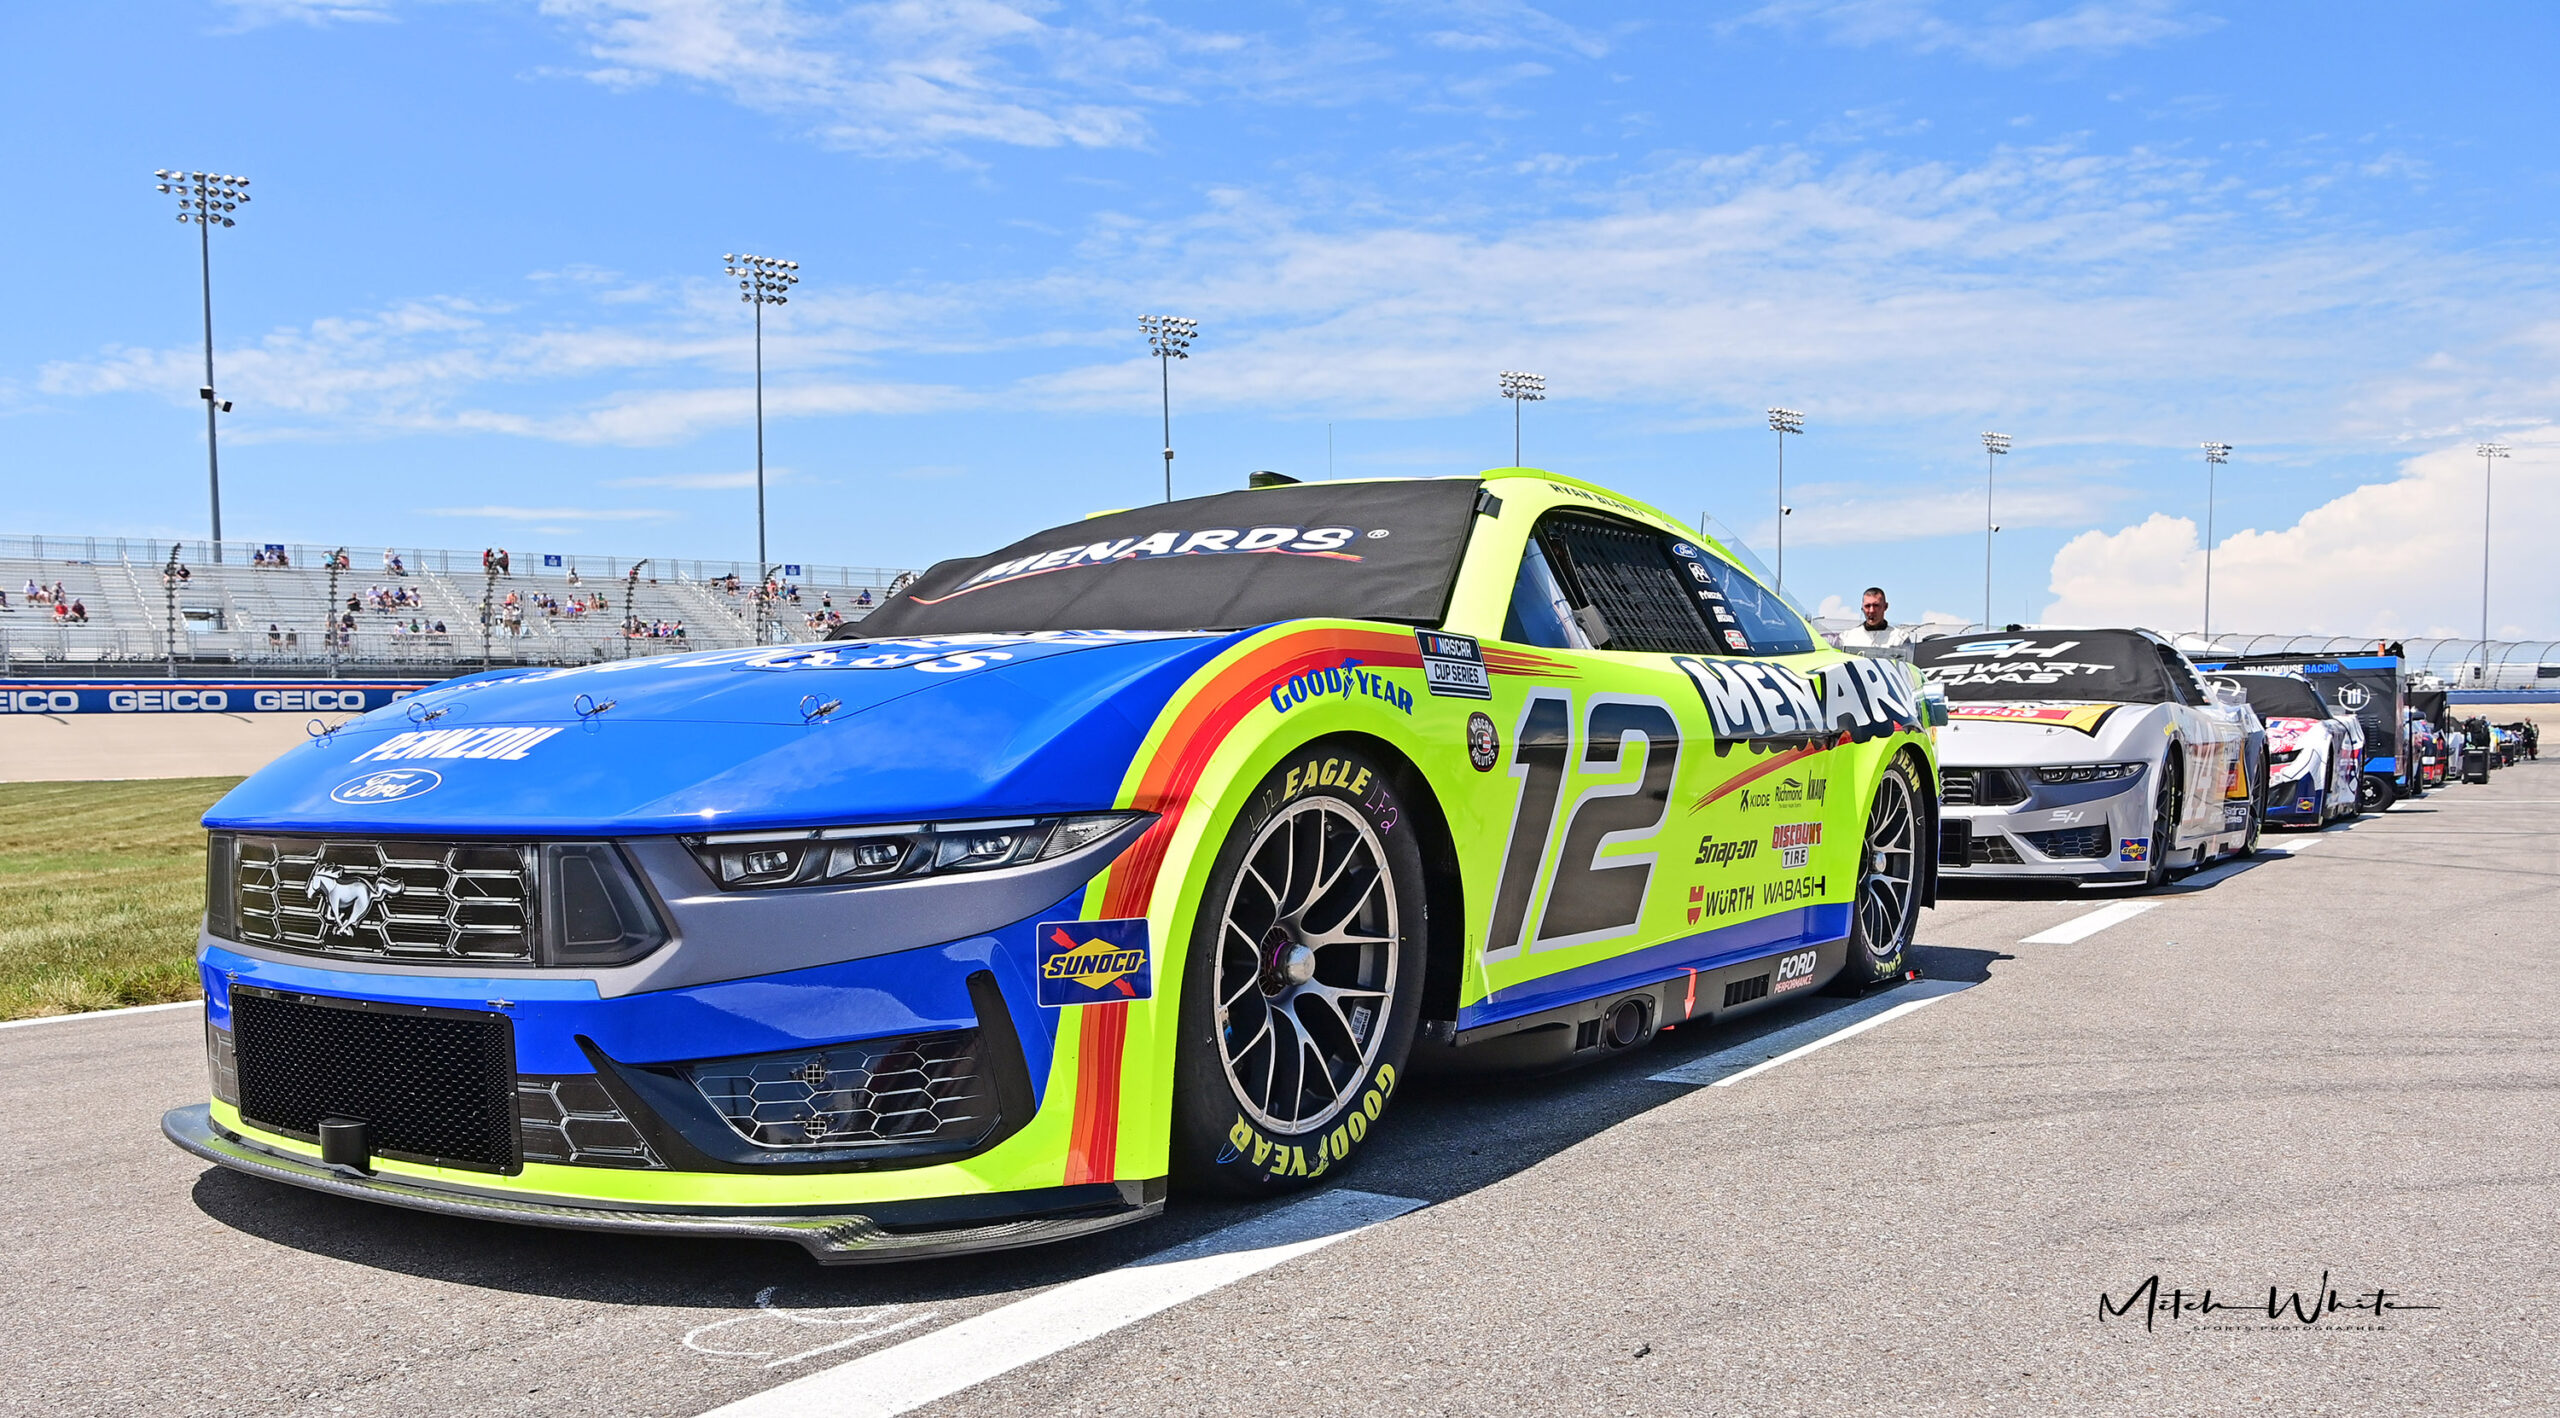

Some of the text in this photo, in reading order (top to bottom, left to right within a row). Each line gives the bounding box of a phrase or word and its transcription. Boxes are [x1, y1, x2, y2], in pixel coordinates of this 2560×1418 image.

[1549, 483, 1593, 501] RYAN
[973, 526, 1354, 584] MENARDS
[1438, 636, 1472, 659] NASCAR
[1434, 663, 1479, 684] CUP SERIES
[1921, 662, 2115, 676] TEWART
[2304, 664, 2339, 674] RACING
[109, 691, 228, 712] GEICO
[254, 691, 366, 711] GEICO
[1470, 717, 1493, 737] NASCAR
[350, 727, 565, 763] PENNZOIL
[1282, 758, 1373, 802] EAGLE
[1750, 793, 1771, 808] KIDDE
[1774, 783, 1803, 802] Richmond
[1481, 686, 1684, 965] 12
[1771, 822, 1822, 849] DISCOUNT
[1695, 835, 1758, 868] Snap-on
[1784, 849, 1806, 865] TIRE
[1763, 875, 1826, 905] WABASH
[1046, 950, 1143, 978] SUNOCO
[1777, 950, 1817, 982] FORD
[1773, 973, 1814, 994] PERFORMANCE
